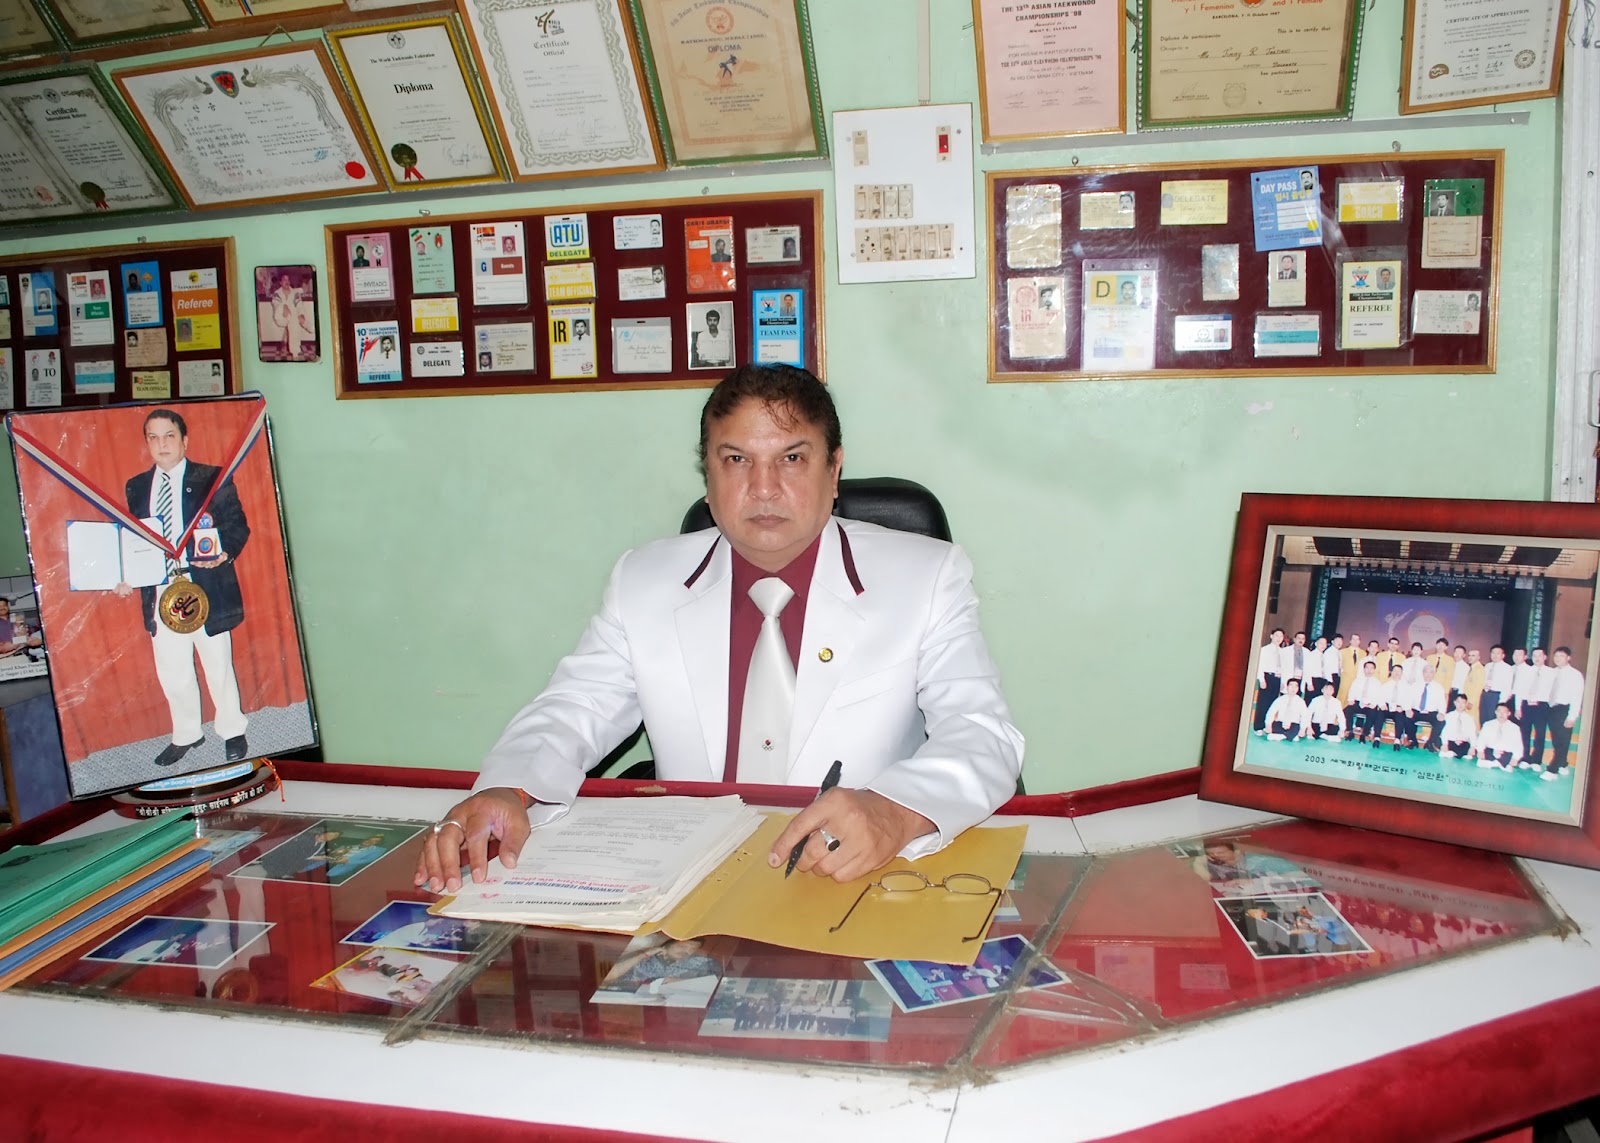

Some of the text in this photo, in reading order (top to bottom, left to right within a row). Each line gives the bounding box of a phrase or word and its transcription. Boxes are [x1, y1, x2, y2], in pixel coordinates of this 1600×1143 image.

[1054, 0, 1096, 8] TAEKWONDO
[1016, 11, 1069, 21] CHAMPIONSHIPS
[1446, 15, 1480, 24] CERTIFICATE
[1490, 9, 1529, 18] APPRECIATION
[534, 40, 570, 49] Certificate
[708, 44, 742, 53] DIPLOMA
[394, 82, 434, 94] Diploma
[46, 108, 78, 116] Certificate
[1260, 181, 1297, 194] DAY PASS
[1356, 206, 1383, 218] COACH
[554, 224, 580, 244] ATU
[481, 262, 487, 272] G
[1096, 281, 1110, 298] D
[177, 298, 213, 310] Referee
[1350, 304, 1392, 312] REFEREE
[553, 320, 566, 342] IR
[43, 368, 56, 377] TO
[1305, 755, 1325, 764] 2003
